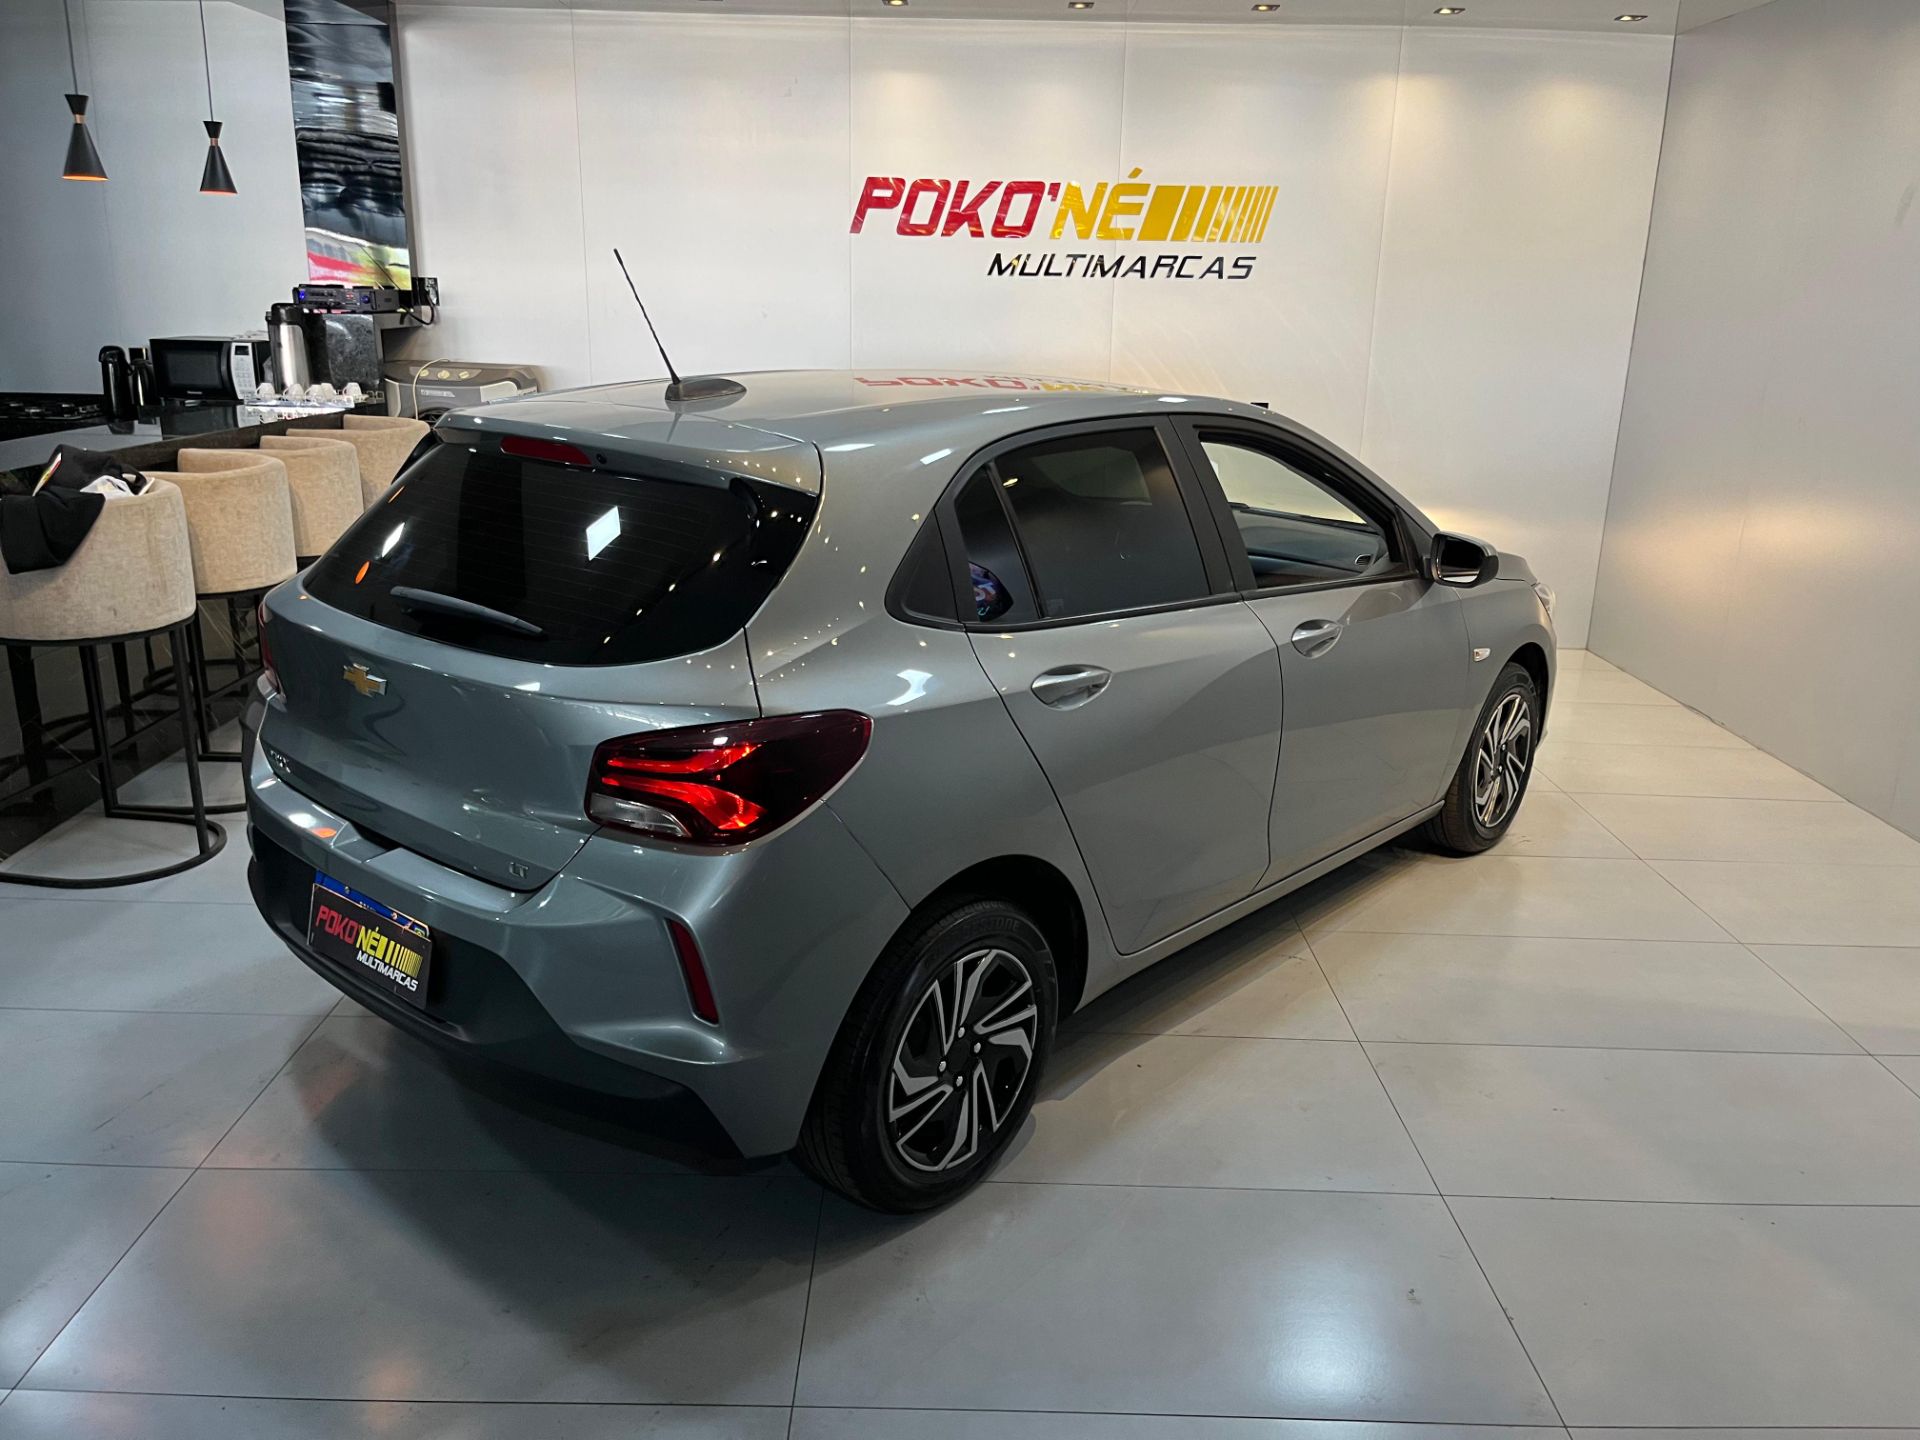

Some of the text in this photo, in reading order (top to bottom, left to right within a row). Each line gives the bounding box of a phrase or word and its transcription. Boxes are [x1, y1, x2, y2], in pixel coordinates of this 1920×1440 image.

[850, 168, 1150, 241] POKO'NÉ
[987, 253, 1257, 280] MULTIMARCAS
[356, 950, 419, 992] MULTIMARCAS
